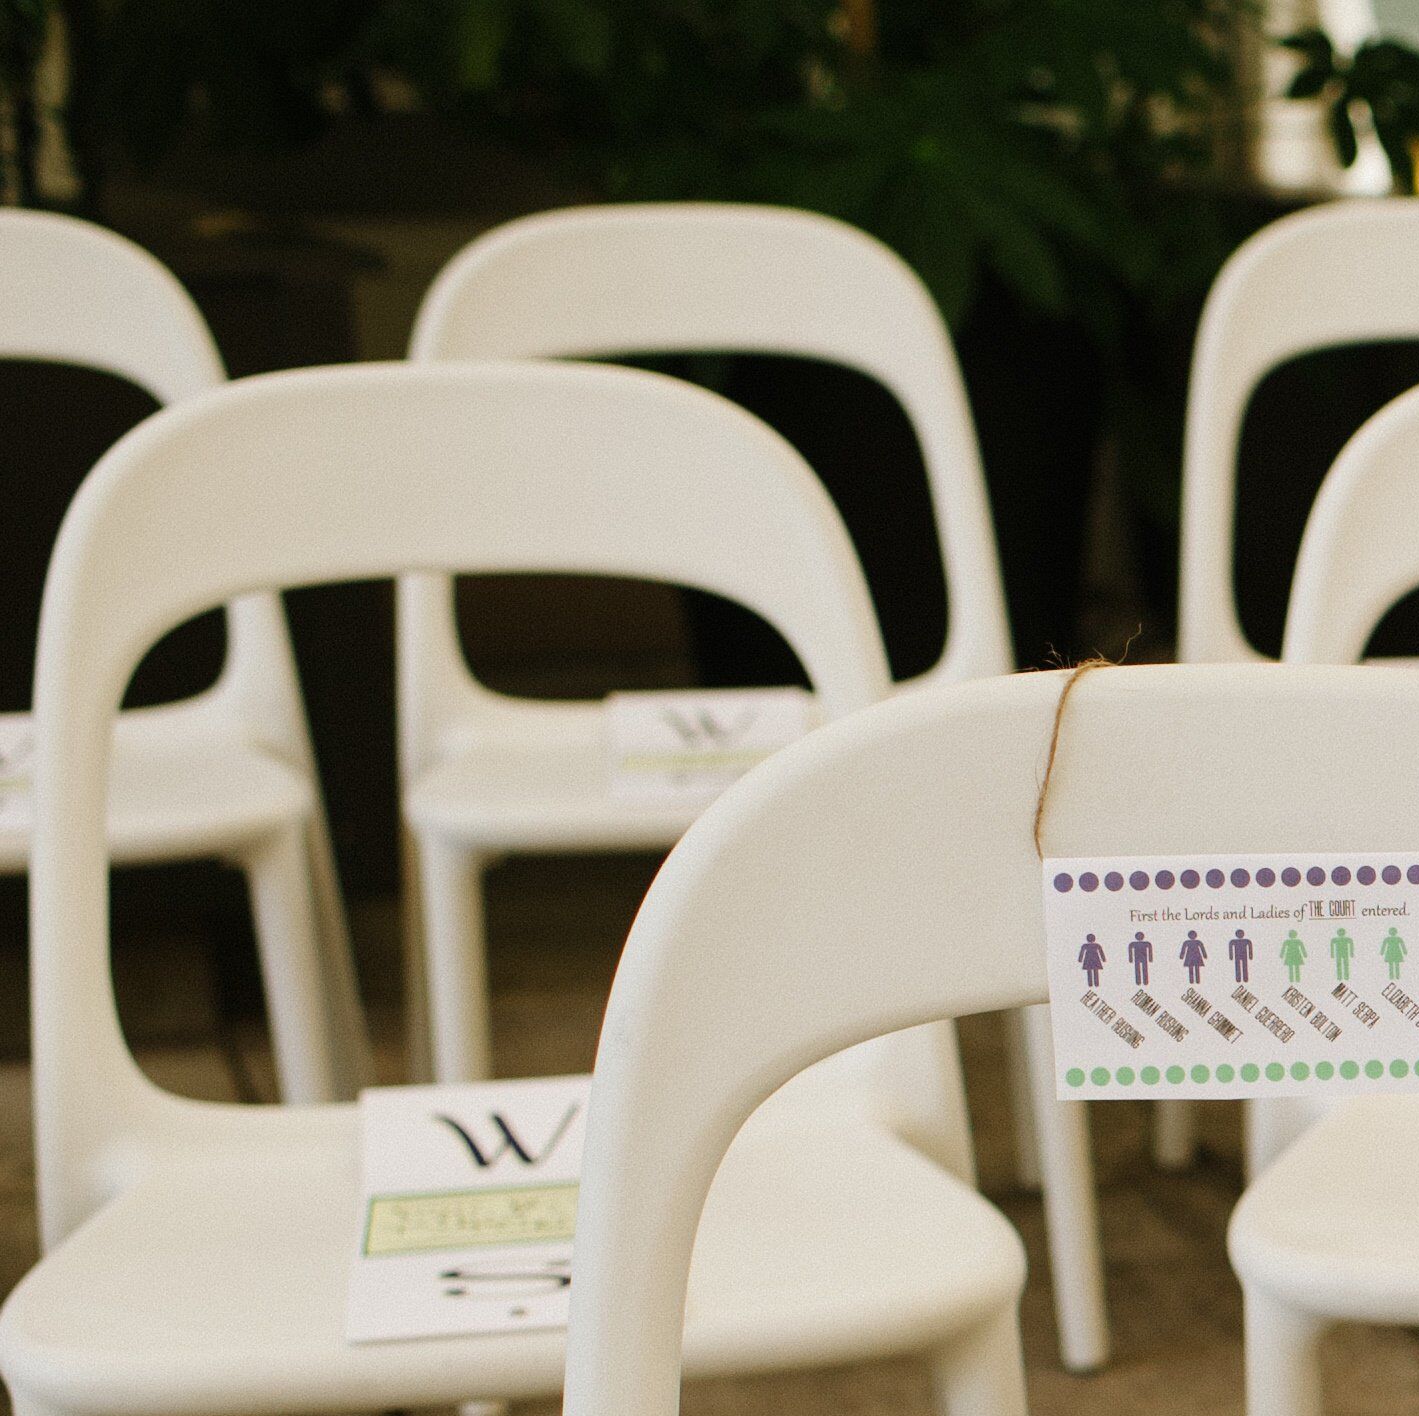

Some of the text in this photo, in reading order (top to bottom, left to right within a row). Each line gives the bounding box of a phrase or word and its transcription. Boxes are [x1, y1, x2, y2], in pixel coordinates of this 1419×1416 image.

[1130, 900, 1410, 922] First the Lords and Ladies of THE COURT entered.
[1080, 989, 1146, 1049] HEATHER RUSHING
[1131, 989, 1189, 1043] ROMAN RUSHING
[1180, 987, 1213, 1018] SHANNA
[1231, 985, 1296, 1044] DANIEL GUERRERO
[1281, 985, 1343, 1042] KRISTEN BOLTON
[1331, 982, 1381, 1029] MATT SERPA
[433, 1102, 579, 1168] W
